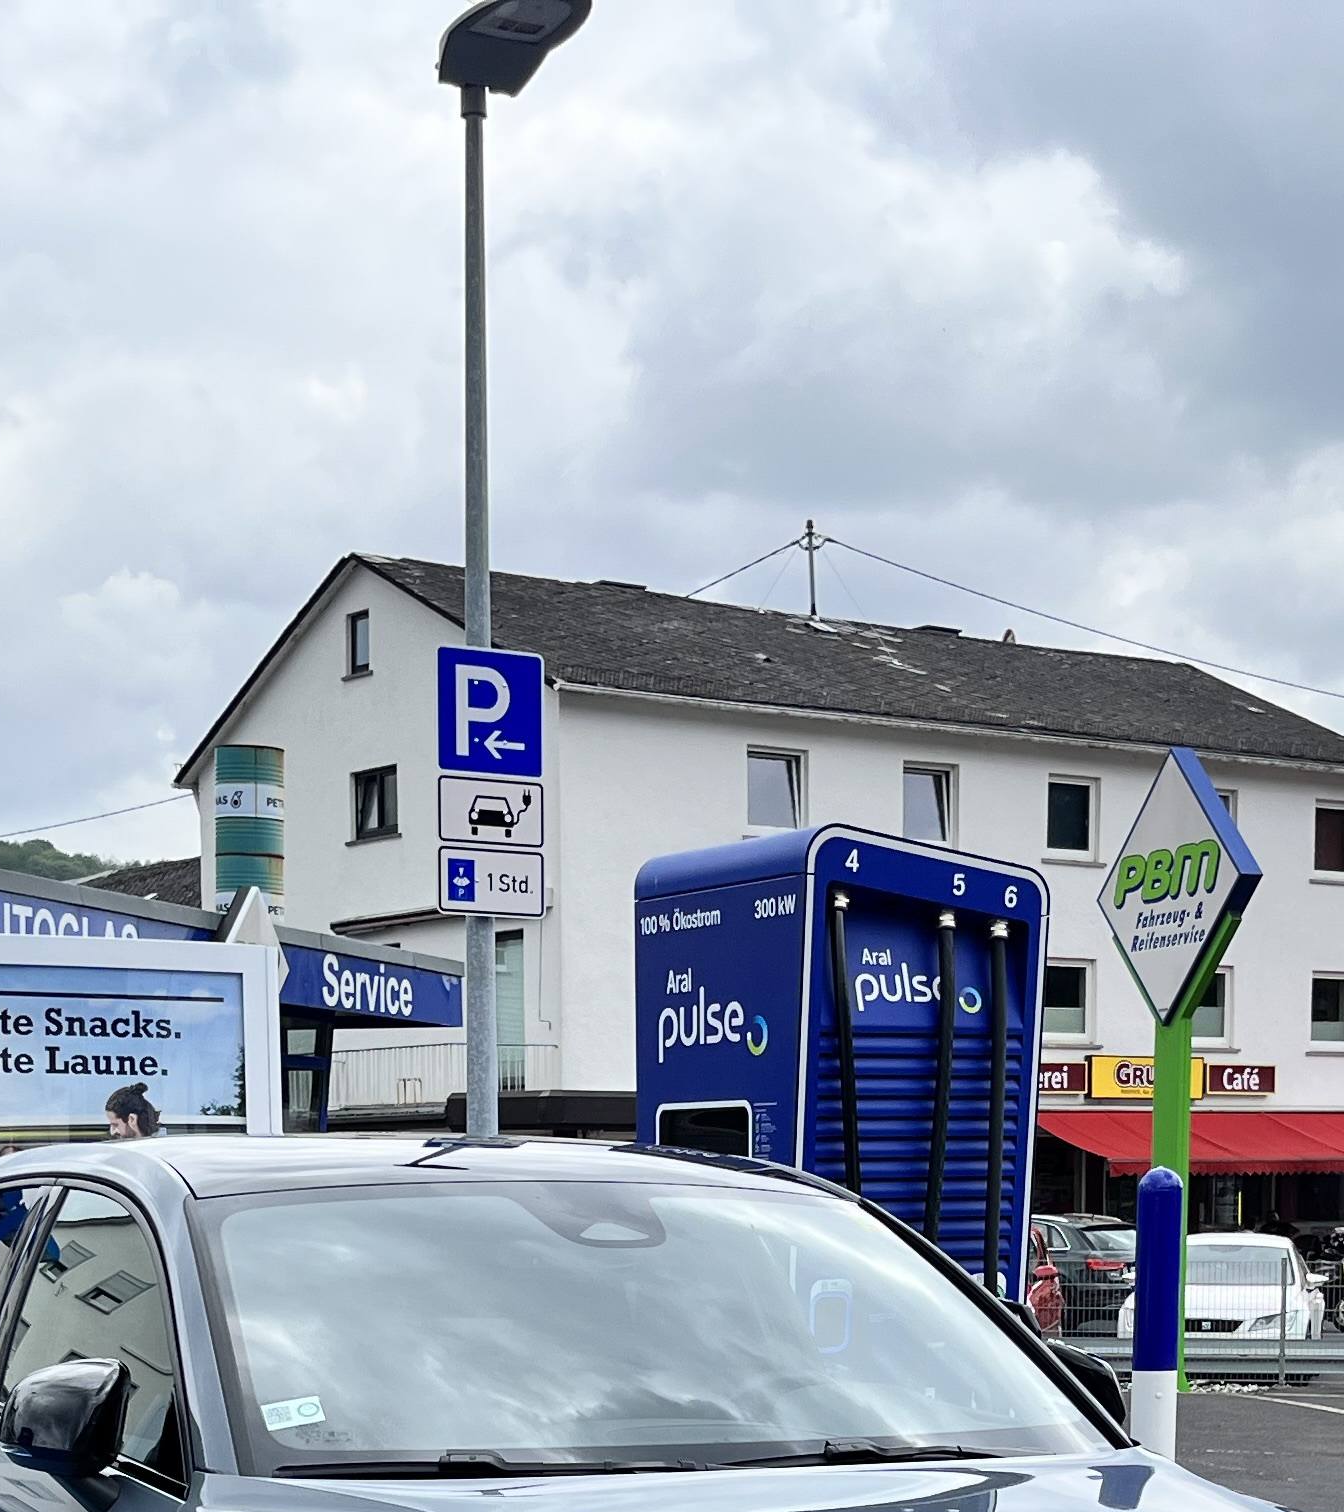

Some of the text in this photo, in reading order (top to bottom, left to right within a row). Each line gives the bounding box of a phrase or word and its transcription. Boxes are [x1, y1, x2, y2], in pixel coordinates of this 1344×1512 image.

[455, 664, 510, 756] P
[845, 849, 860, 872] 4
[1113, 838, 1220, 909] PBM
[487, 873, 534, 894] 1 Std.
[953, 873, 965, 896] 5
[754, 894, 796, 919] 300 kW
[1004, 886, 1018, 908] 6
[640, 908, 721, 936] 100 % Ökostrom
[1194, 903, 1204, 919] &
[1130, 927, 1206, 953] Reifenservice
[862, 948, 892, 967] Aral
[321, 953, 413, 1017] Service
[666, 967, 692, 994] Aral
[44, 1006, 182, 1040] Snacks.
[658, 986, 745, 1063] pulse
[44, 1047, 169, 1077] Laune.
[1115, 1061, 1154, 1087] GRU
[1222, 1068, 1260, 1091] Café
